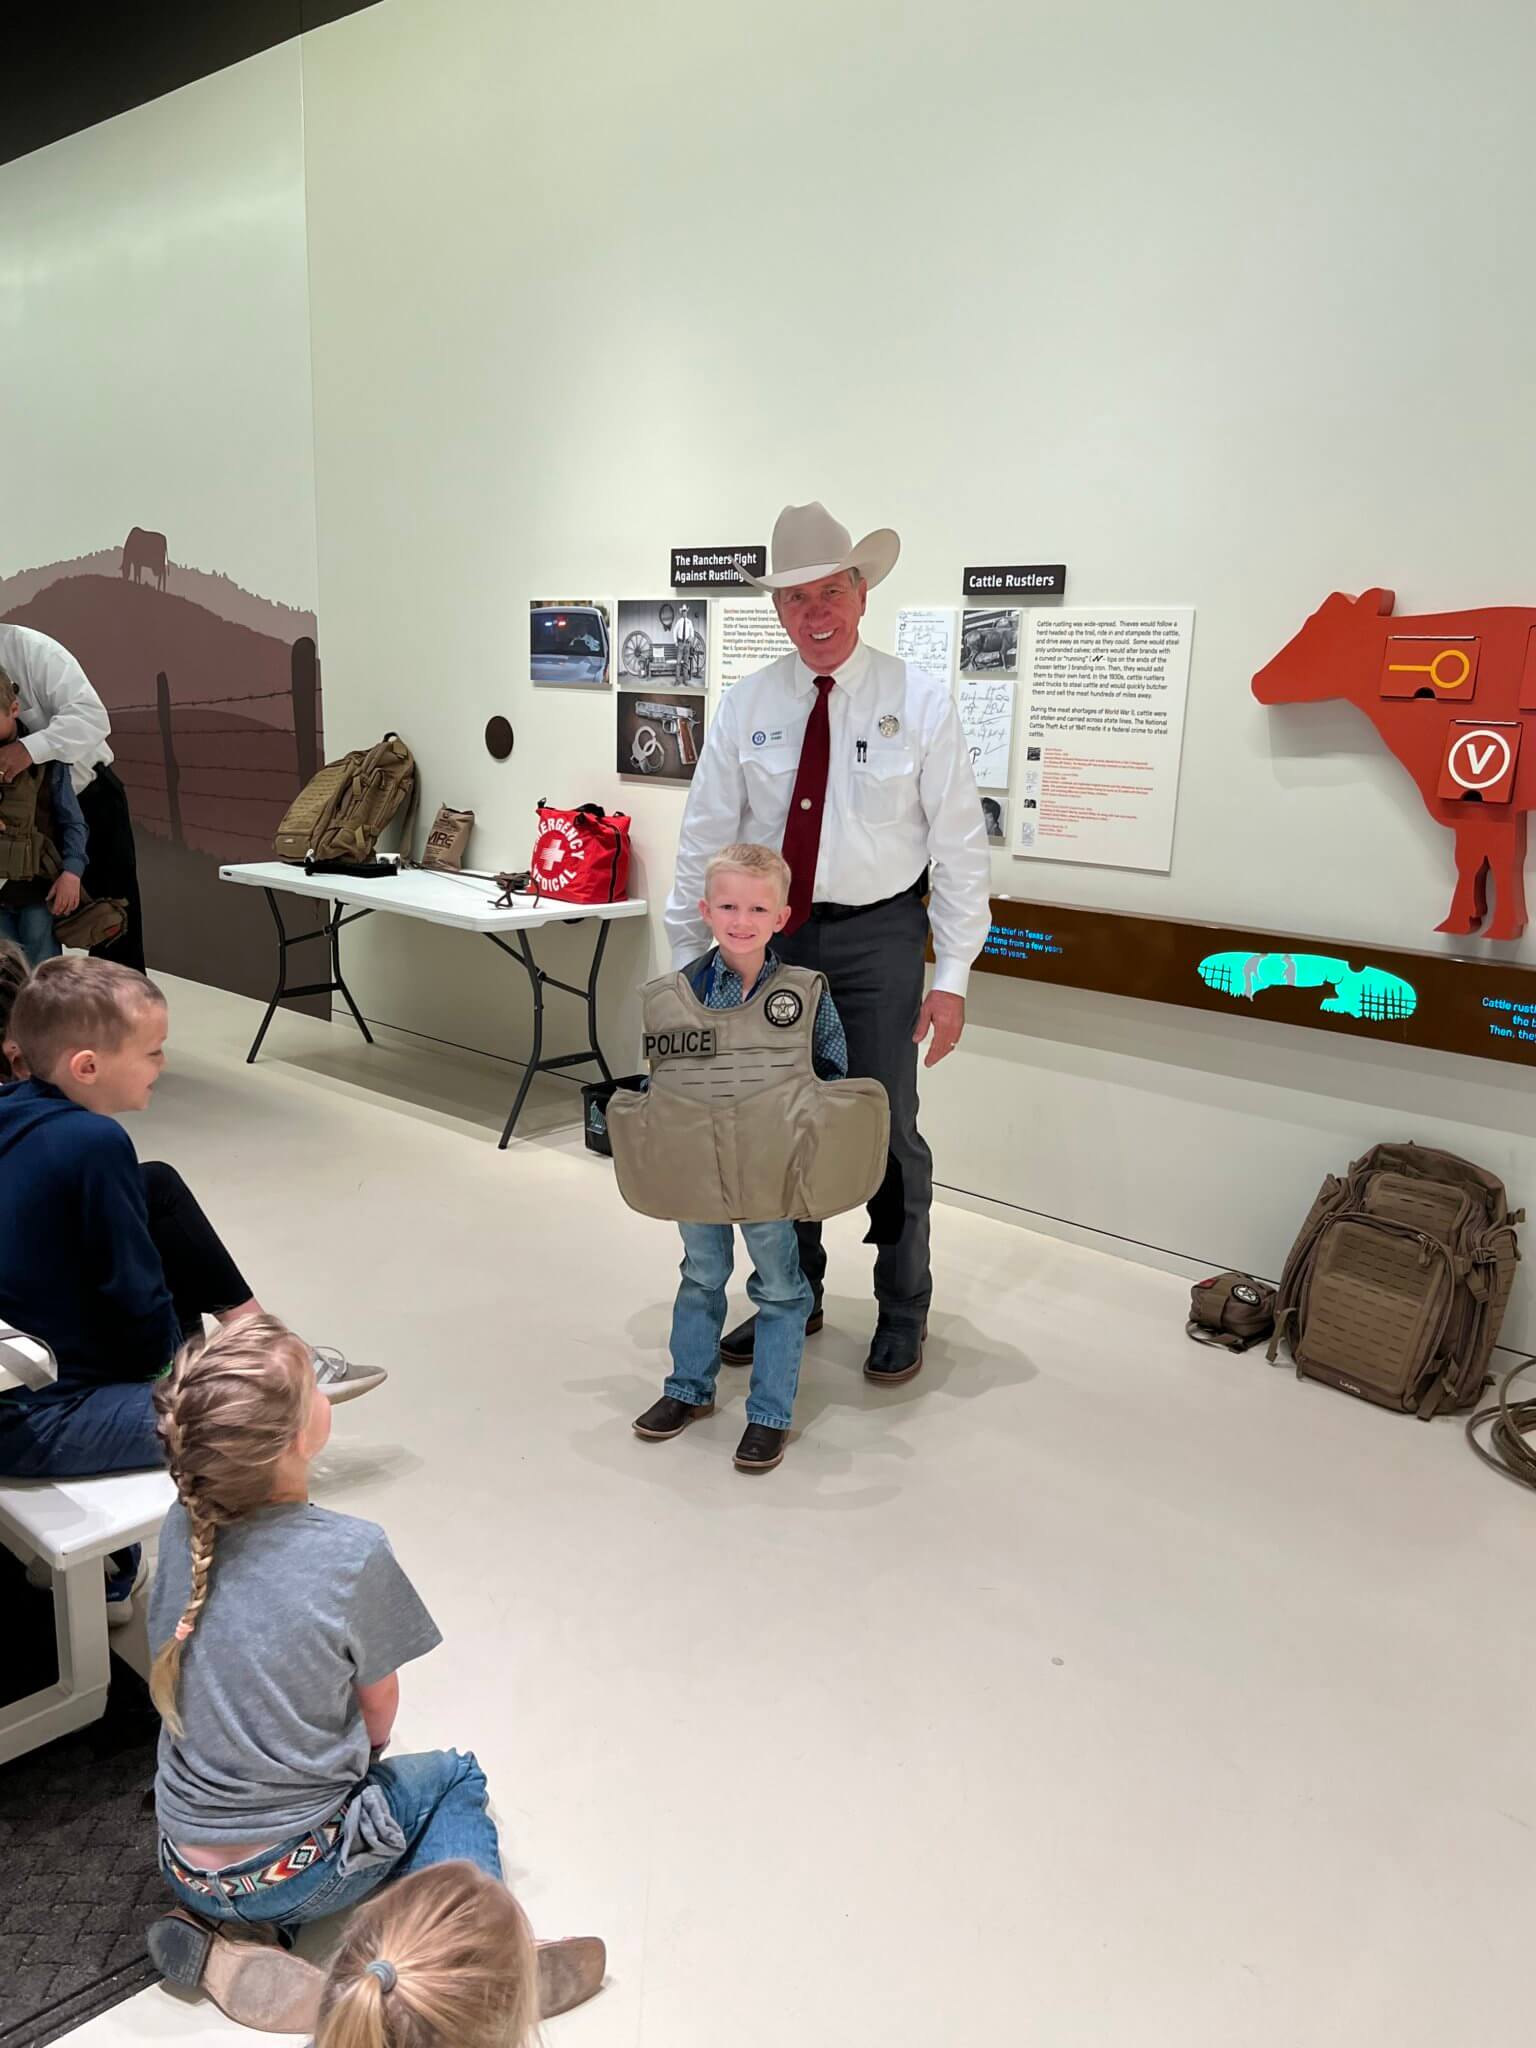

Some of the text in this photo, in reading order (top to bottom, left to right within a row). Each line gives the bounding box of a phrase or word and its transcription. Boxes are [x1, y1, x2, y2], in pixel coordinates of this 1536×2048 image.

[675, 552, 757, 566] The Ranchers Fight
[675, 571, 706, 583] Against
[969, 574, 1054, 588] Cattle Rustlers
[1466, 744, 1497, 775] V
[535, 818, 584, 860] ERGENCY
[1482, 998, 1511, 1010] Cattle
[646, 1030, 710, 1056] POLICE
[1518, 1030, 1536, 1043] the
